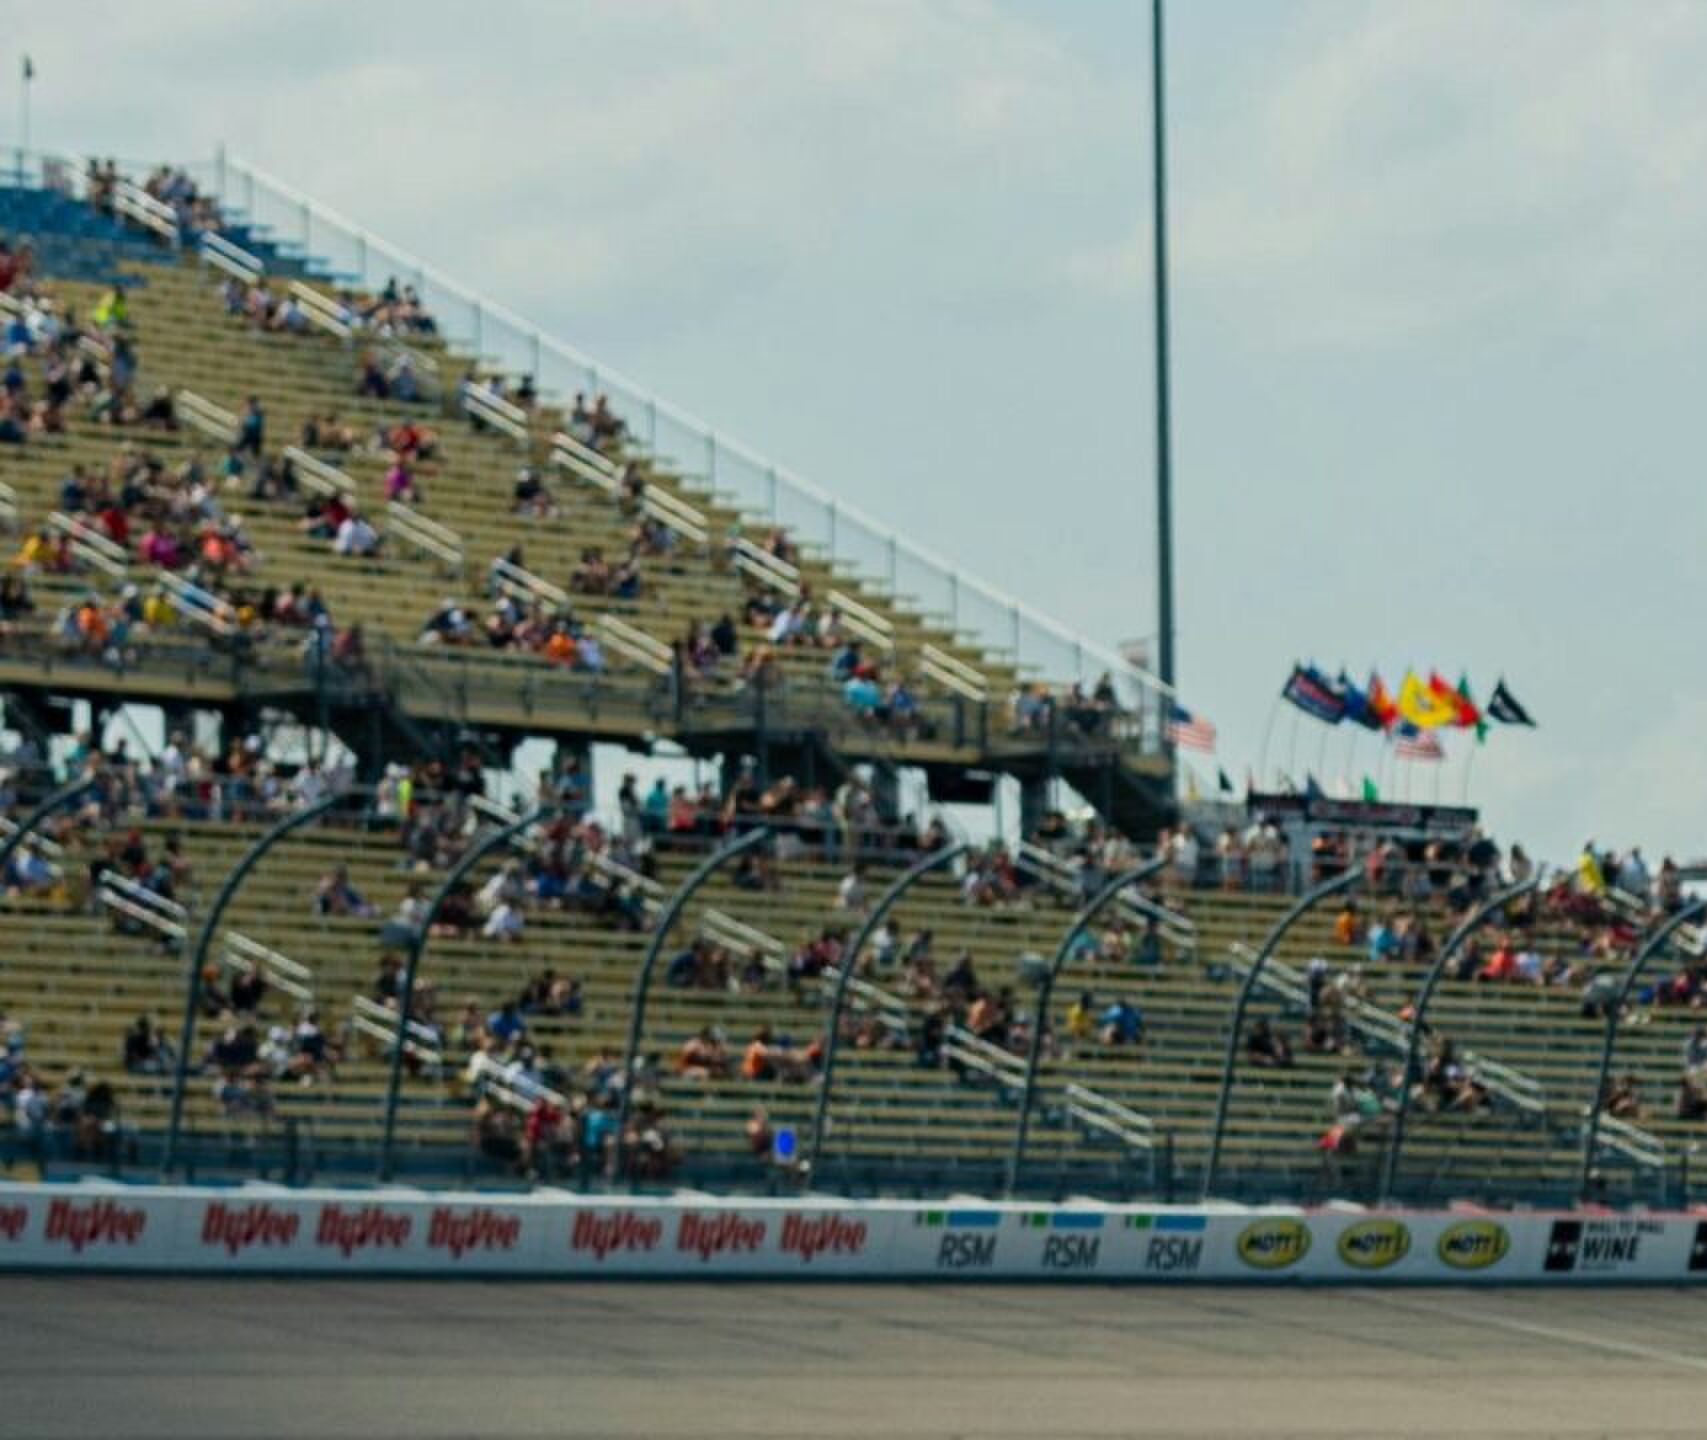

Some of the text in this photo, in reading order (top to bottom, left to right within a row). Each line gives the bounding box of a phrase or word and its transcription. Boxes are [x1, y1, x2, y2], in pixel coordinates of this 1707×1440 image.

[936, 1233, 1204, 1270] RSM RSM RSM
[1583, 1236, 1640, 1262] WINE
